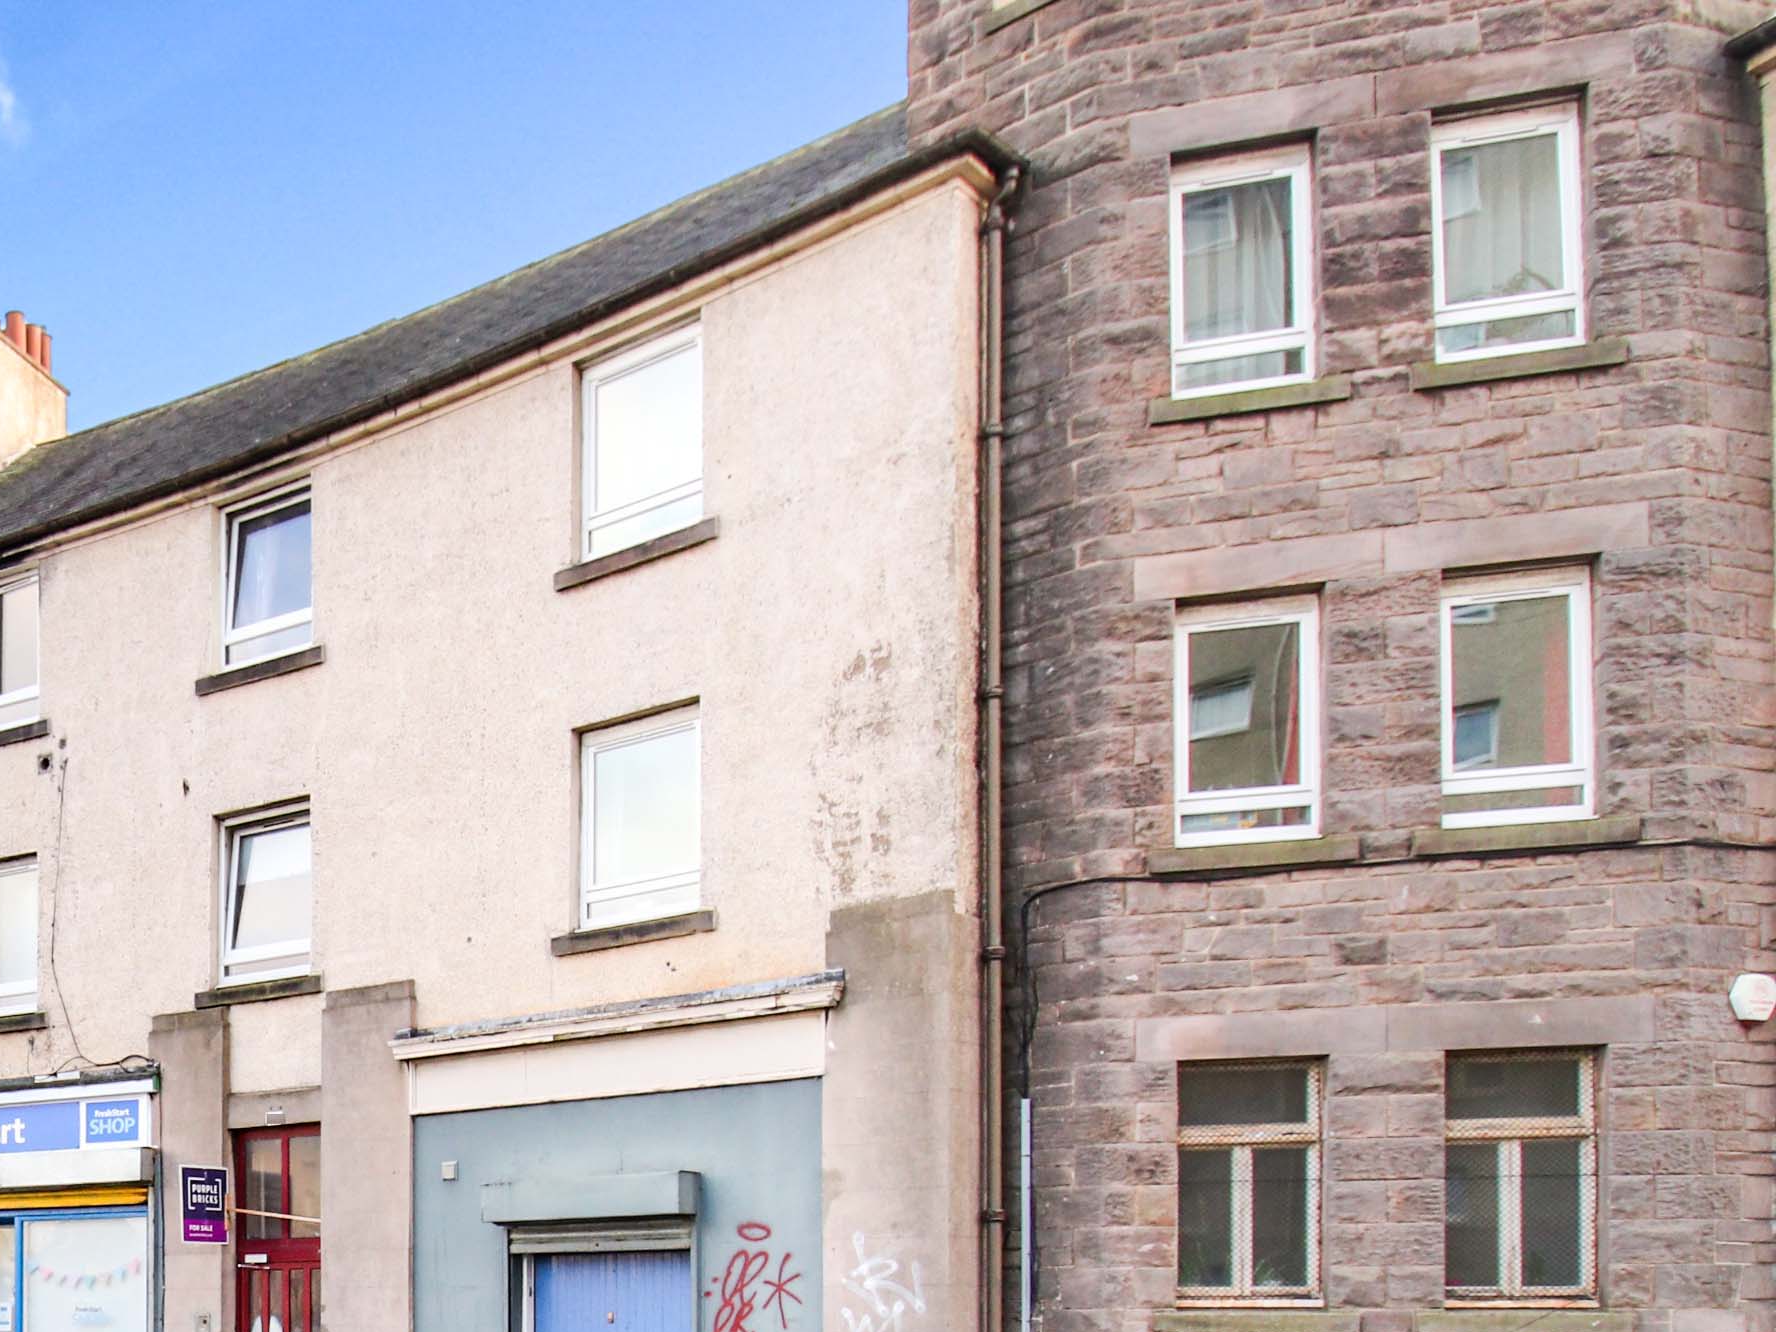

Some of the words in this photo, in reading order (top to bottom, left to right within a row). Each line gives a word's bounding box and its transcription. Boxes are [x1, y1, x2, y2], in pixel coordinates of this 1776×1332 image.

[89, 1117, 136, 1135] SHOP
[191, 1183, 218, 1194] PURPLE
[191, 1194, 218, 1204] BRICKS
[200, 1224, 213, 1232] SALE
